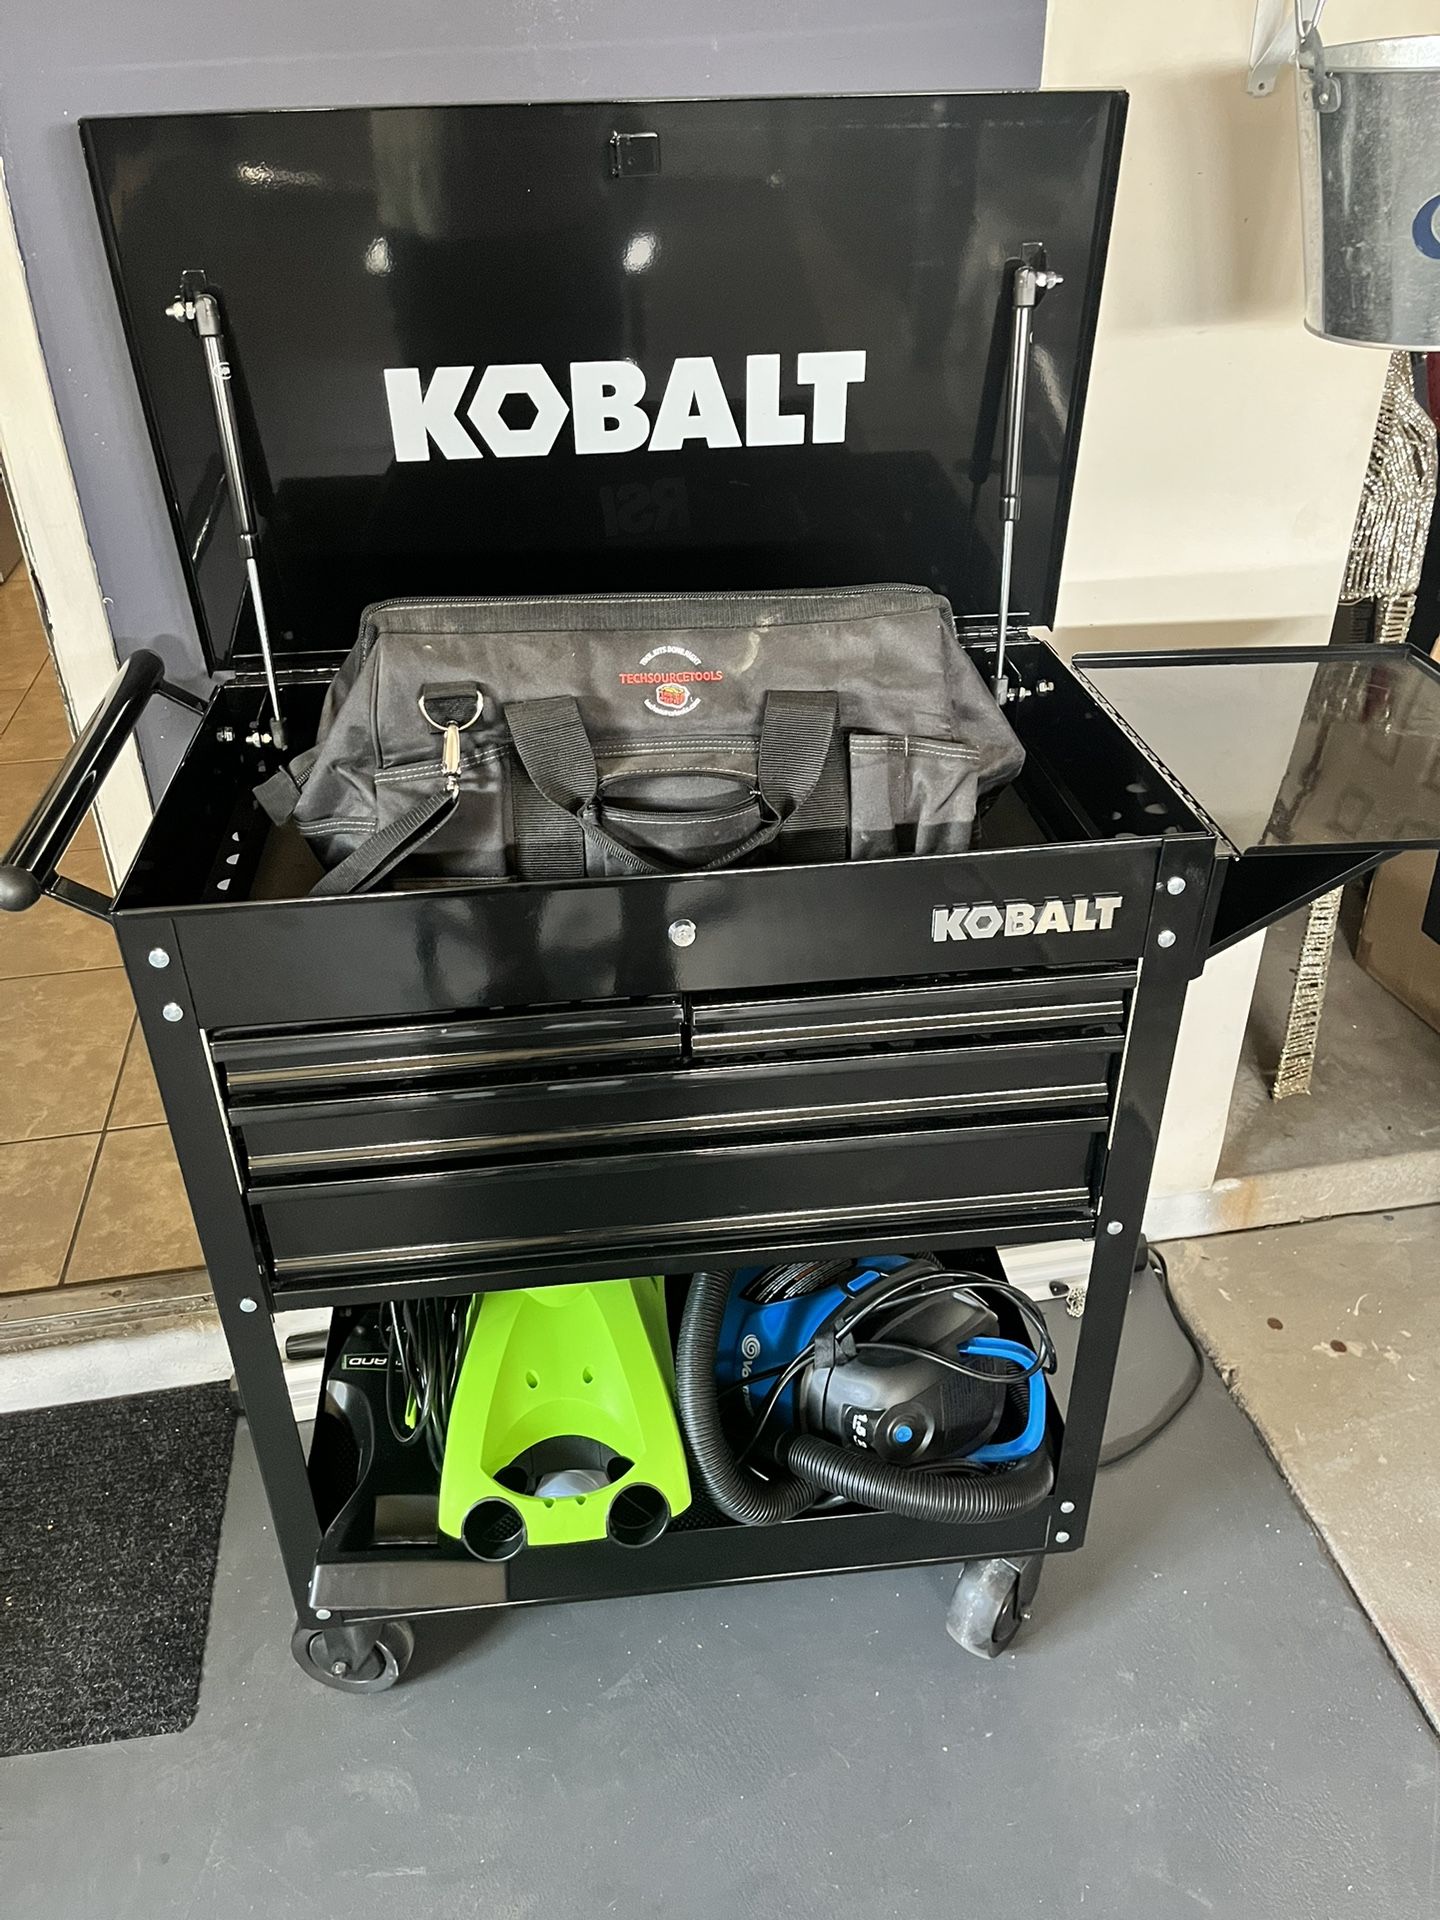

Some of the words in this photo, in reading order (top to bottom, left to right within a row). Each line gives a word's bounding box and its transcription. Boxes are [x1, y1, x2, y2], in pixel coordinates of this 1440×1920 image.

[384, 351, 866, 462] KOBALT
[619, 670, 724, 684] TECHSOURCETOOLS
[933, 896, 1123, 942] KOBALT
